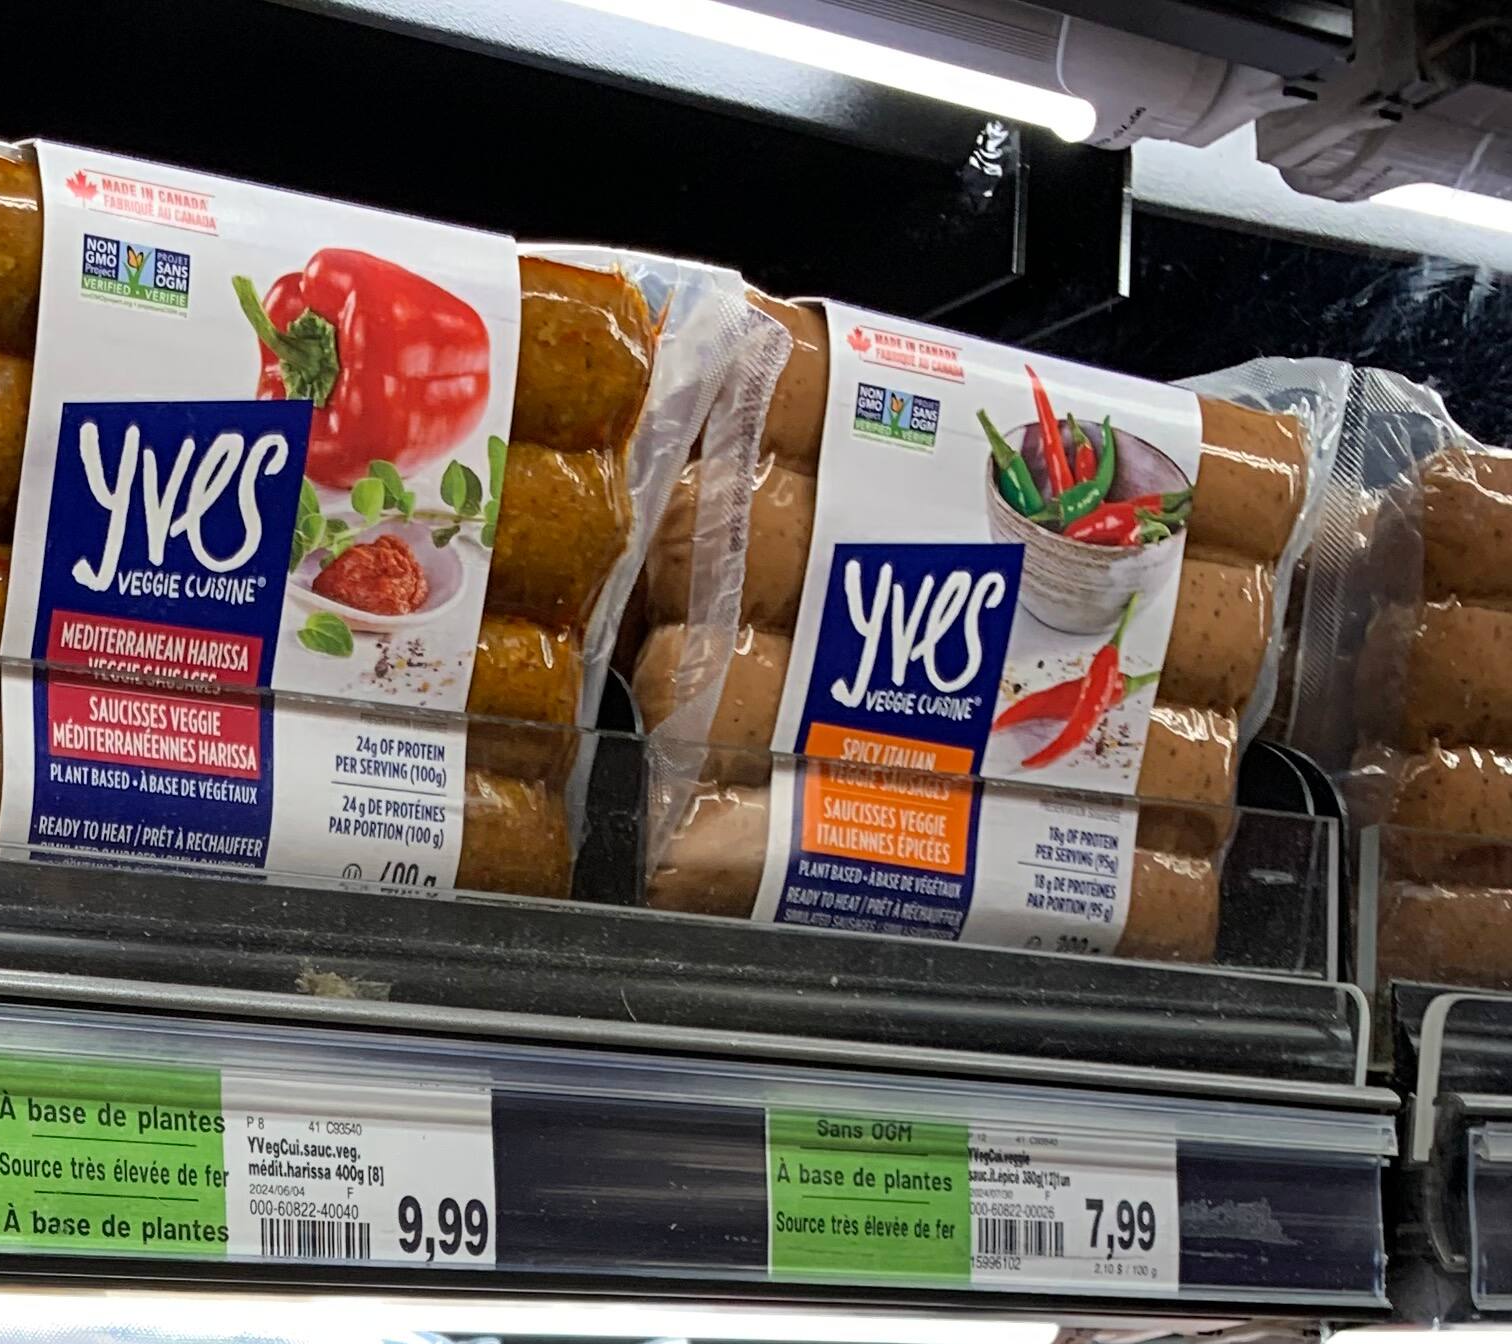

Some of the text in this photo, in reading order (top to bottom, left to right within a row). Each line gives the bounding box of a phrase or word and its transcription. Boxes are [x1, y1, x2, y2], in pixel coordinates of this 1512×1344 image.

[60, 622, 249, 673] MEDITERRANEAN HARISSA
[89, 695, 221, 737] SAUCISSES VEGGIE
[52, 720, 258, 772] MÉDITERRANÉENNES HARISSA
[38, 815, 80, 838] READY
[83, 820, 99, 840] TO
[101, 822, 133, 844] HEAT
[143, 825, 175, 848] PRÊT
[176, 826, 184, 849] À
[823, 797, 947, 838] SAUCISSES VEGGIE
[817, 825, 951, 866] ITALIENNES ÉPICÉES
[817, 1119, 913, 1142] Sans OGM
[335, 1165, 364, 1185] 400g
[250, 1199, 359, 1220] 000-60822-40040
[398, 1195, 488, 1262] 9,99
[1085, 1198, 1156, 1260] 7,99
